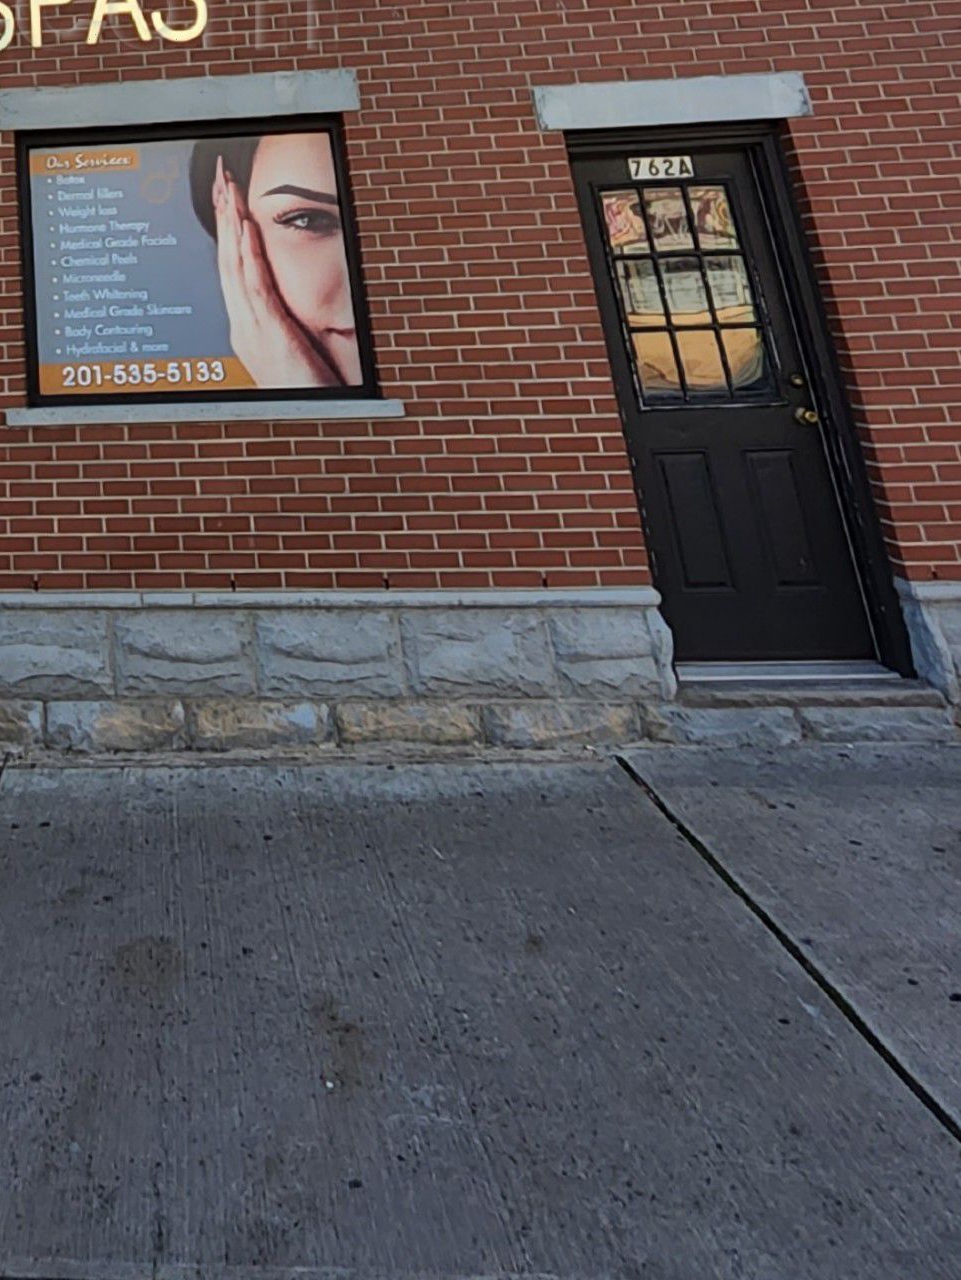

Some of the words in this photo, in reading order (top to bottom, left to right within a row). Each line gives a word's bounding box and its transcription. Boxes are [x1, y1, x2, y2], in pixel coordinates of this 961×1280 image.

[631, 157, 692, 177] 762A
[58, 188, 94, 200] Dermal
[58, 206, 96, 219] Weight
[98, 204, 118, 215] loss
[59, 223, 107, 234] Hormone
[109, 220, 150, 233] Therapy
[60, 238, 102, 250] Medical
[104, 236, 139, 248] Grade
[141, 234, 177, 246] Facials
[60, 254, 110, 267] Chemical
[111, 252, 138, 264] Peels
[63, 289, 90, 301] Teeth
[92, 288, 148, 301] Whitening
[64, 305, 107, 319] Medical
[108, 304, 144, 317] Grade
[146, 302, 192, 315] Skincare
[64, 326, 92, 340] Body
[94, 323, 153, 337] Contouring
[130, 341, 138, 353] &
[142, 342, 169, 352] more
[62, 361, 225, 388] 201-535-5133
